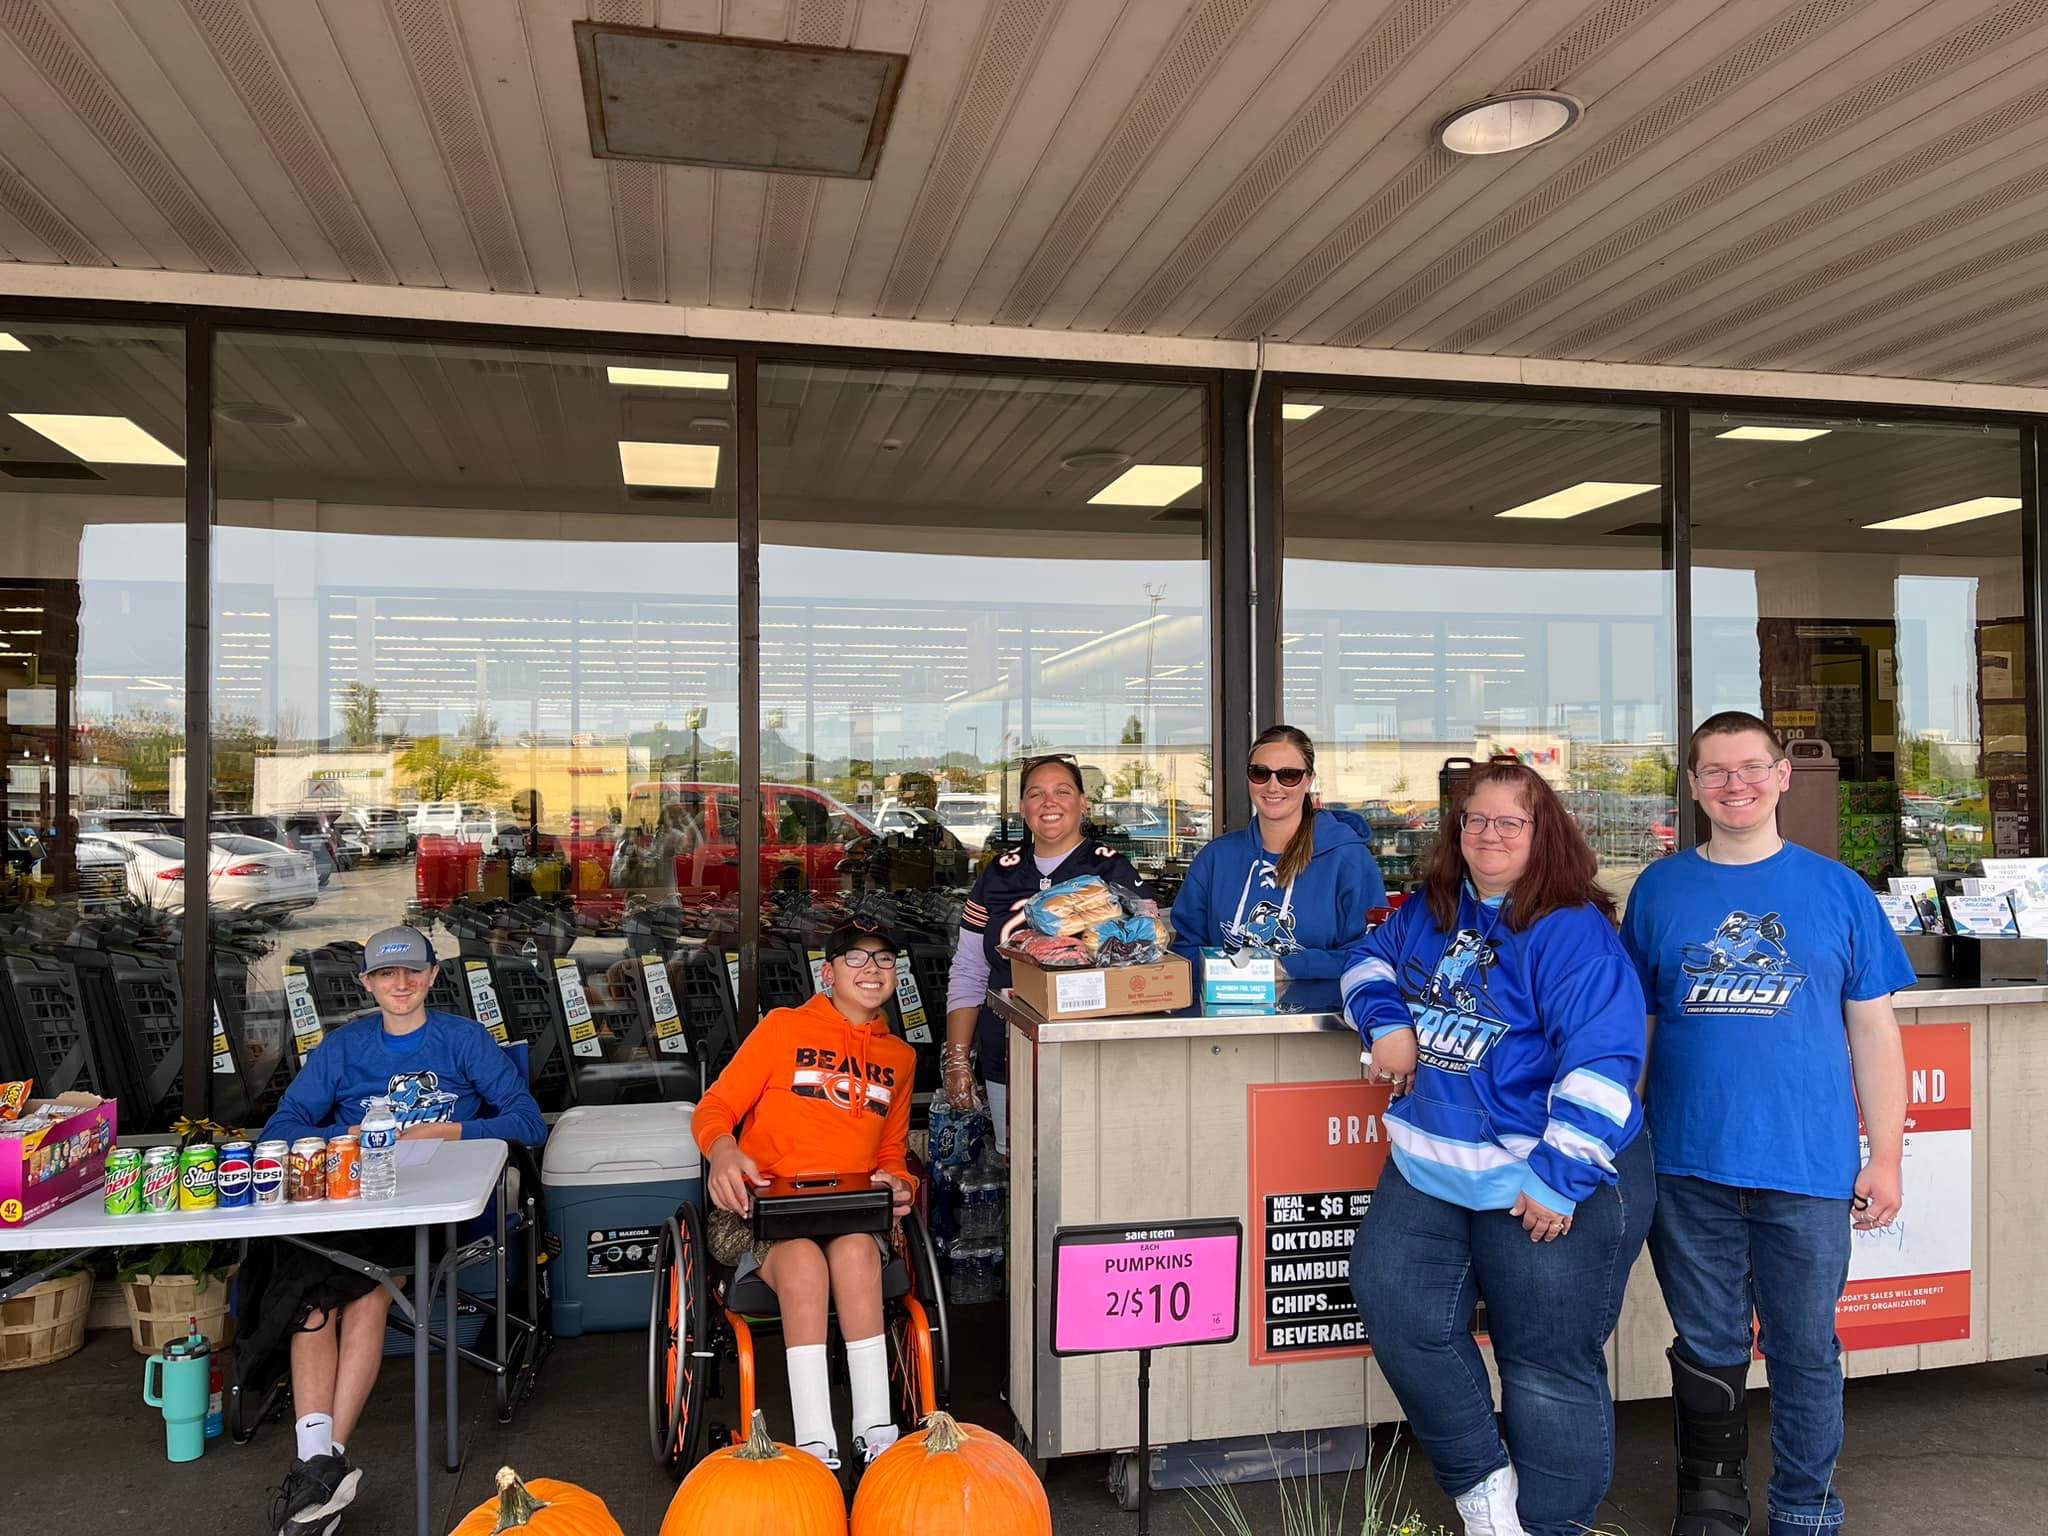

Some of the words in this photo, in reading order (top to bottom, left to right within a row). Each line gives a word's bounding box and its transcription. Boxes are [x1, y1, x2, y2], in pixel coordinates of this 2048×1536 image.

[1686, 973, 1802, 1004] FROST
[795, 1047, 895, 1087] BEARS
[1905, 1069, 1947, 1105] ND
[1328, 1114, 1391, 1146] BRA
[219, 1172, 250, 1182] PEPSI
[253, 1171, 282, 1180] PEPSI
[4, 1203, 17, 1214] 42
[1273, 1196, 1304, 1209] MEAL
[1320, 1194, 1344, 1220] $6
[1273, 1209, 1305, 1223] DEAL
[1125, 1231, 1147, 1241] sale
[1149, 1229, 1175, 1239] item
[1271, 1229, 1358, 1251] OKTOBER
[1140, 1243, 1160, 1252] EACH
[1105, 1253, 1193, 1274] PUMPKINS
[1271, 1260, 1350, 1283] HAMBUR
[1870, 1290, 1893, 1300] SALES
[1895, 1289, 1912, 1297] WILL
[1913, 1286, 1944, 1296] BENEFIT
[1872, 1299, 1926, 1310] ORGANIZATION
